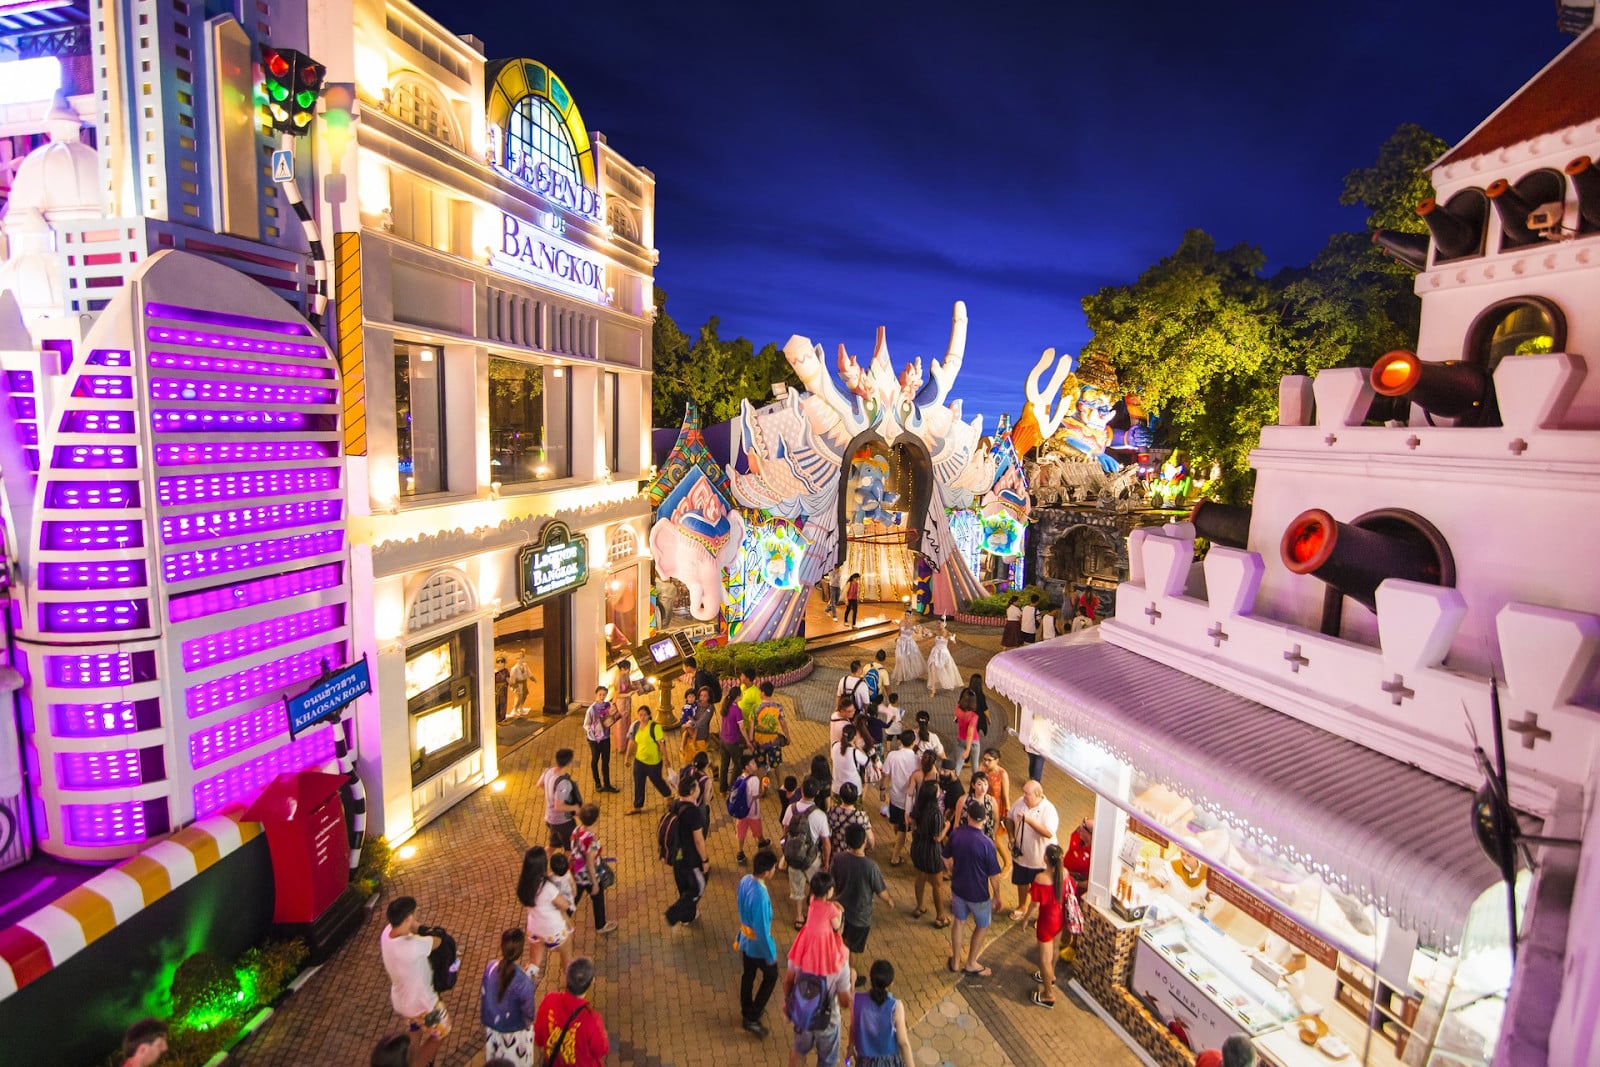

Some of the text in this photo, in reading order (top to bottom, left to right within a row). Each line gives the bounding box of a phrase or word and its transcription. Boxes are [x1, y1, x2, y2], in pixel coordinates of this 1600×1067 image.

[500, 212, 603, 291] BANGKOK
[295, 680, 367, 727] KHAOSAN ROAD
[303, 674, 357, 709] ถนนข้าวสาร
